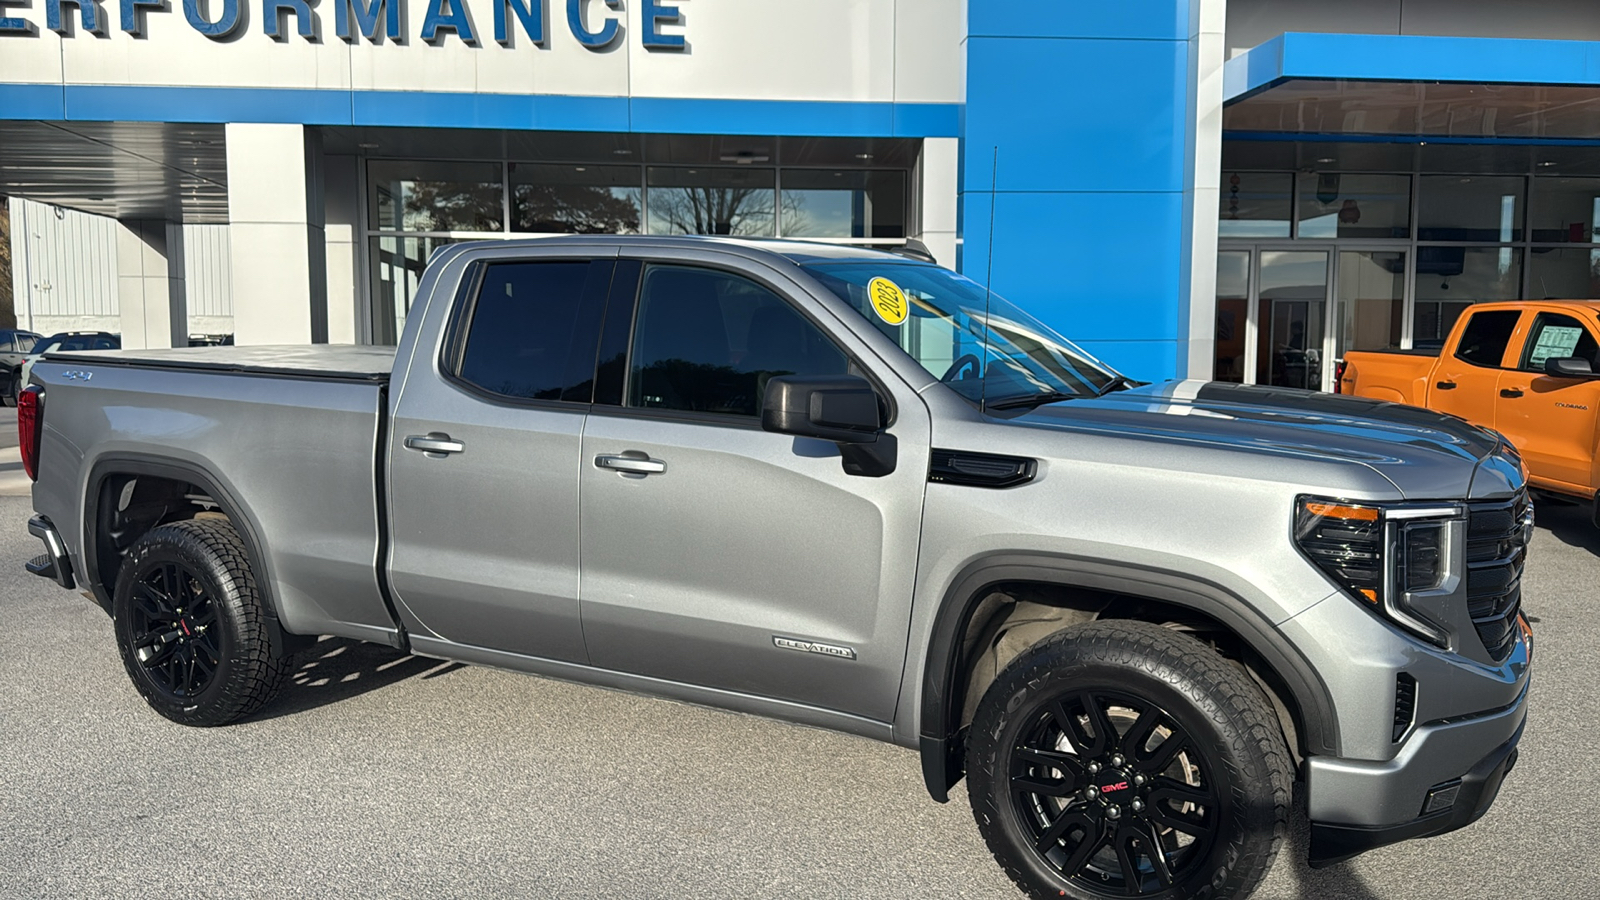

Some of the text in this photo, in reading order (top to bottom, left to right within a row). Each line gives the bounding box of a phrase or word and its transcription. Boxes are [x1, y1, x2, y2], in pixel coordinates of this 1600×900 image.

[0, 0, 687, 50] ORMANCE
[876, 281, 901, 319] 2023
[777, 639, 850, 656] ELEVATION
[1101, 781, 1129, 793] GMC
